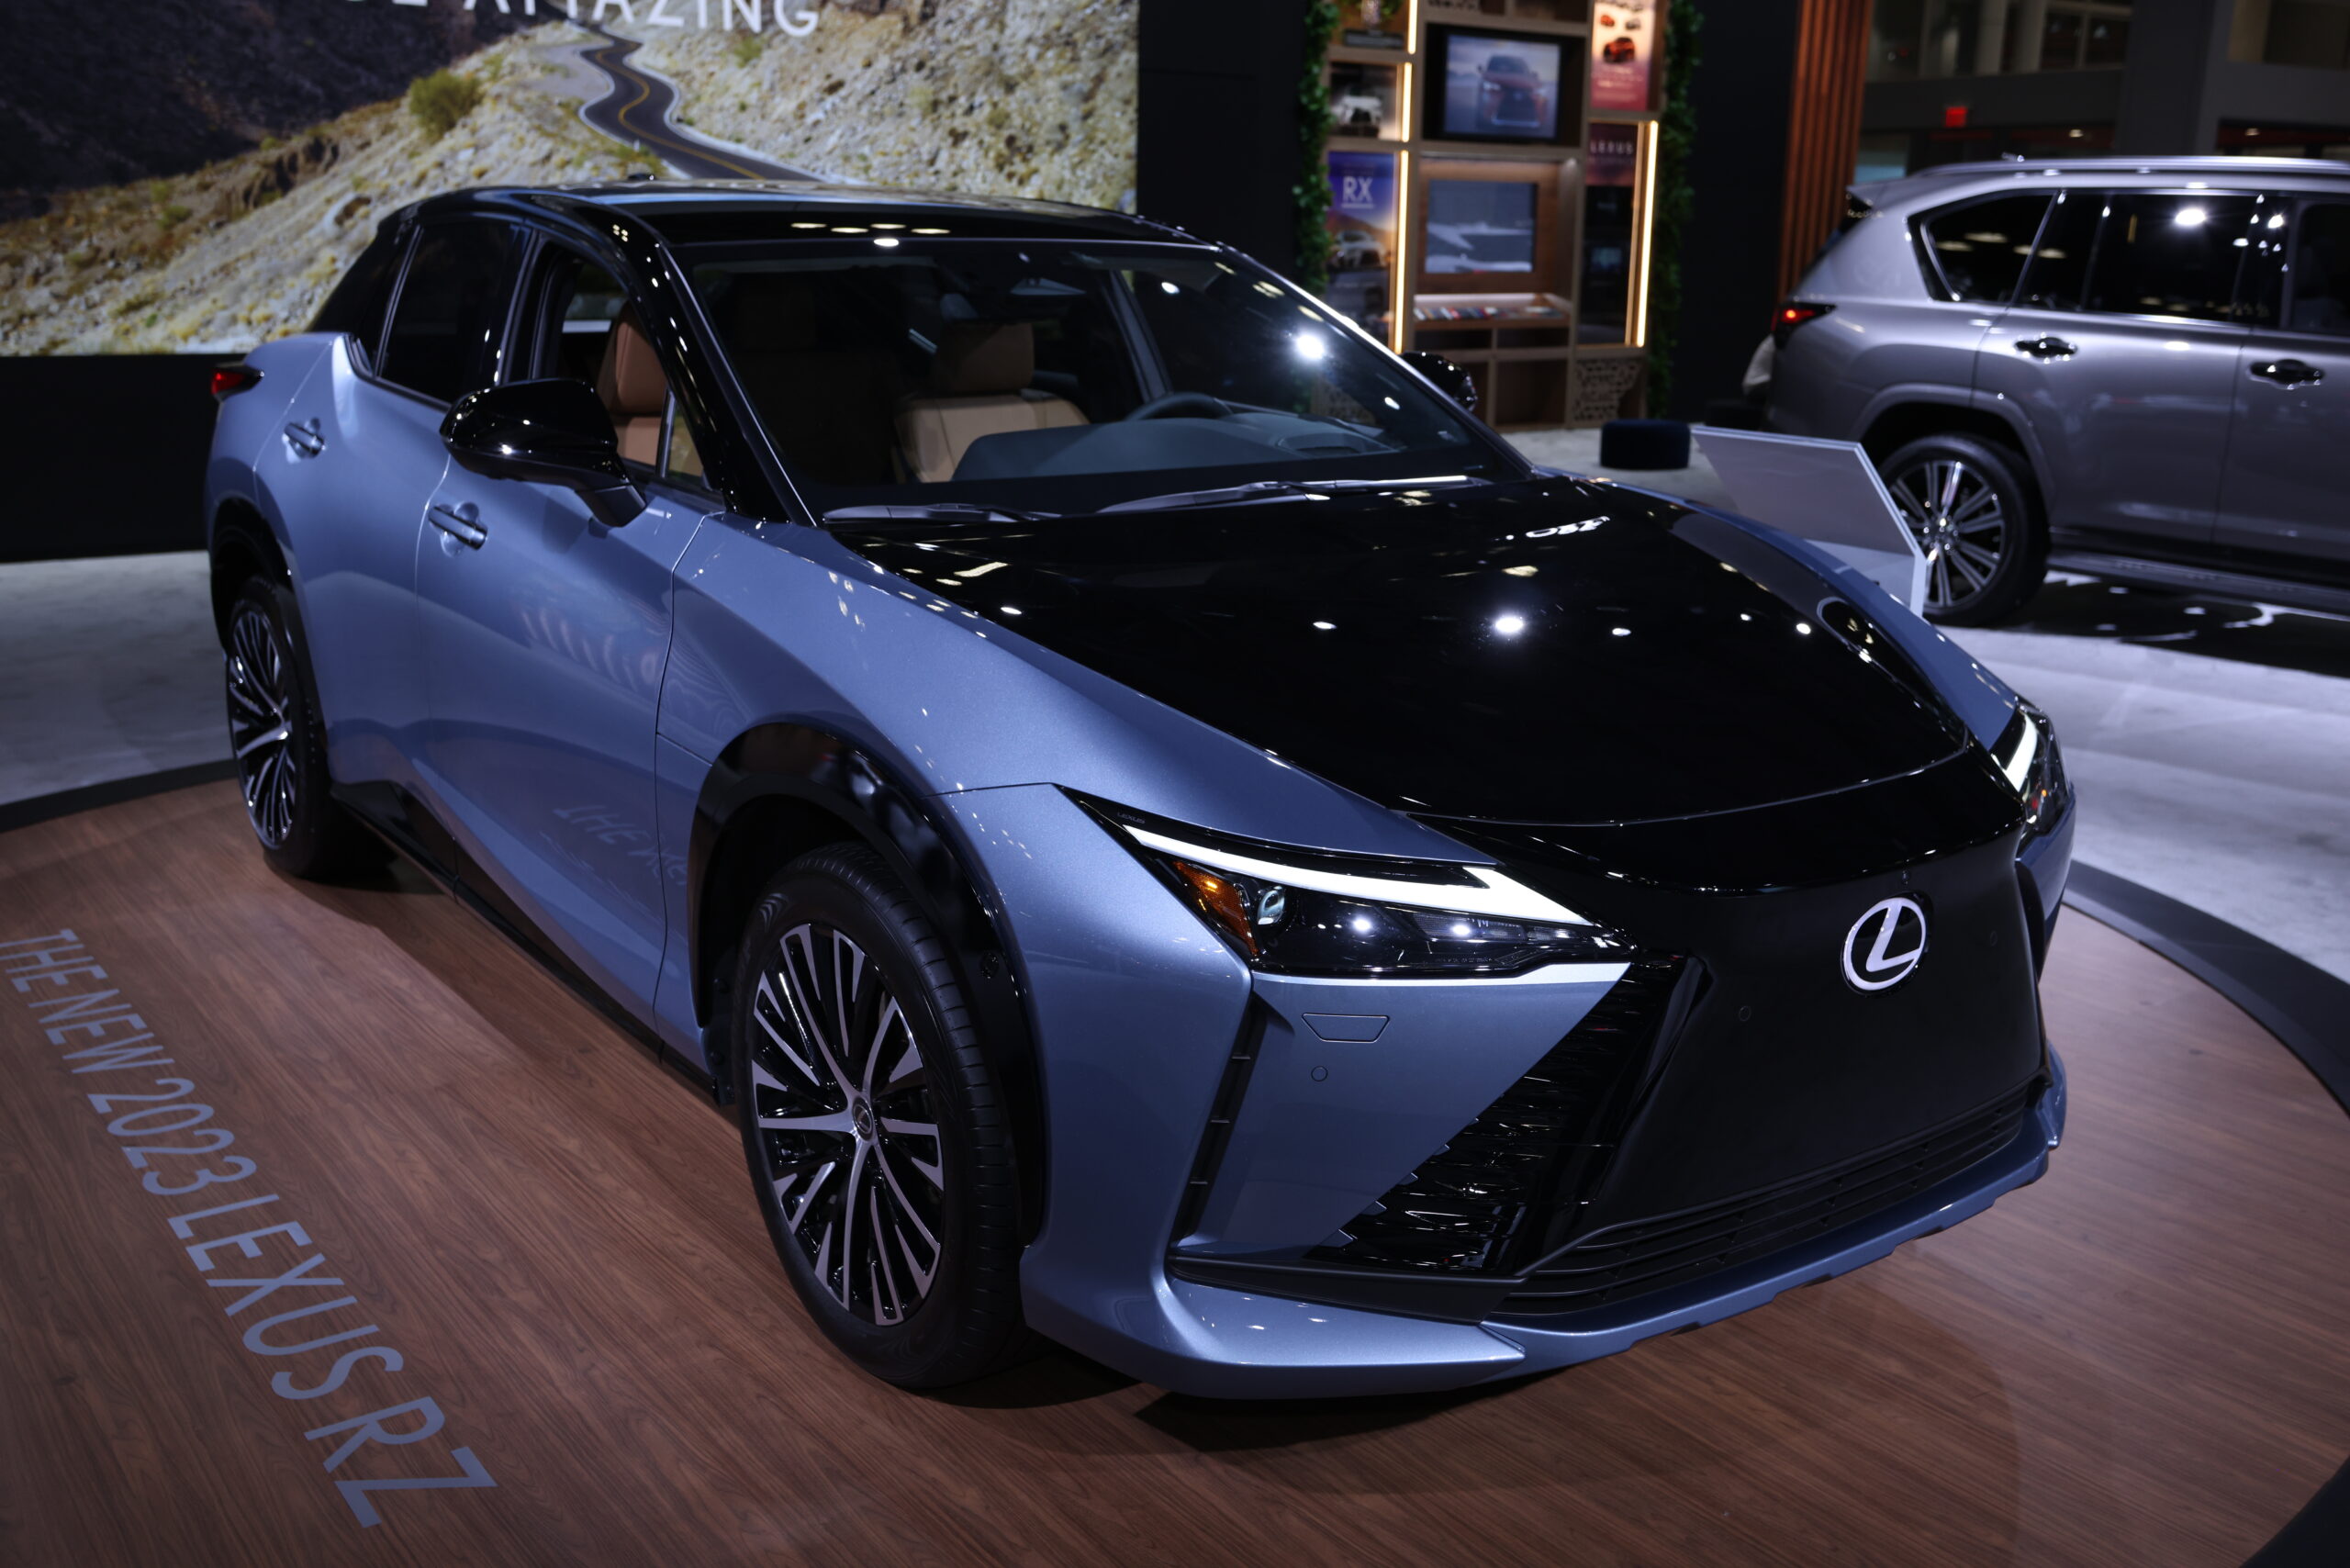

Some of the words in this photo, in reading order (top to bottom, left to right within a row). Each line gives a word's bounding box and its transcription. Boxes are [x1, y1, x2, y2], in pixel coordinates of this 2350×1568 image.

[1343, 175, 1373, 202] RX
[1117, 812, 1146, 824] LEXUS
[0, 928, 108, 992] THE
[28, 989, 174, 1074] NEW
[87, 1078, 257, 1195] 2023
[167, 1193, 404, 1400] LEXUS
[304, 1396, 498, 1529] RZ
